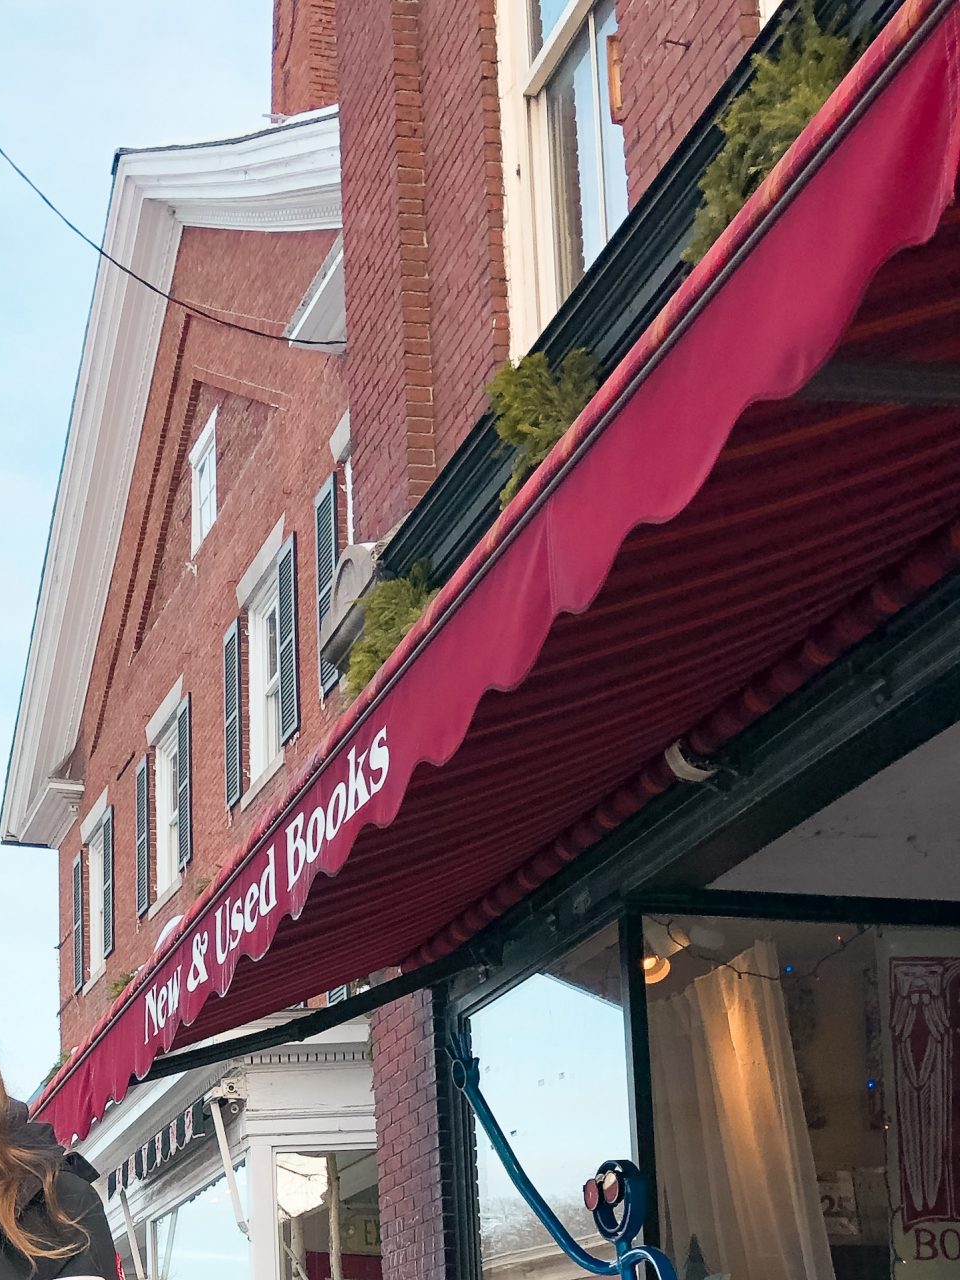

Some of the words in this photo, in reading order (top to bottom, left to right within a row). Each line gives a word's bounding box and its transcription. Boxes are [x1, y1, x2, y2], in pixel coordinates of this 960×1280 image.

[143, 964, 182, 1046] New
[186, 930, 209, 992] &
[214, 844, 277, 965] Used
[284, 725, 391, 893] Books
[914, 1228, 960, 1261] BO
